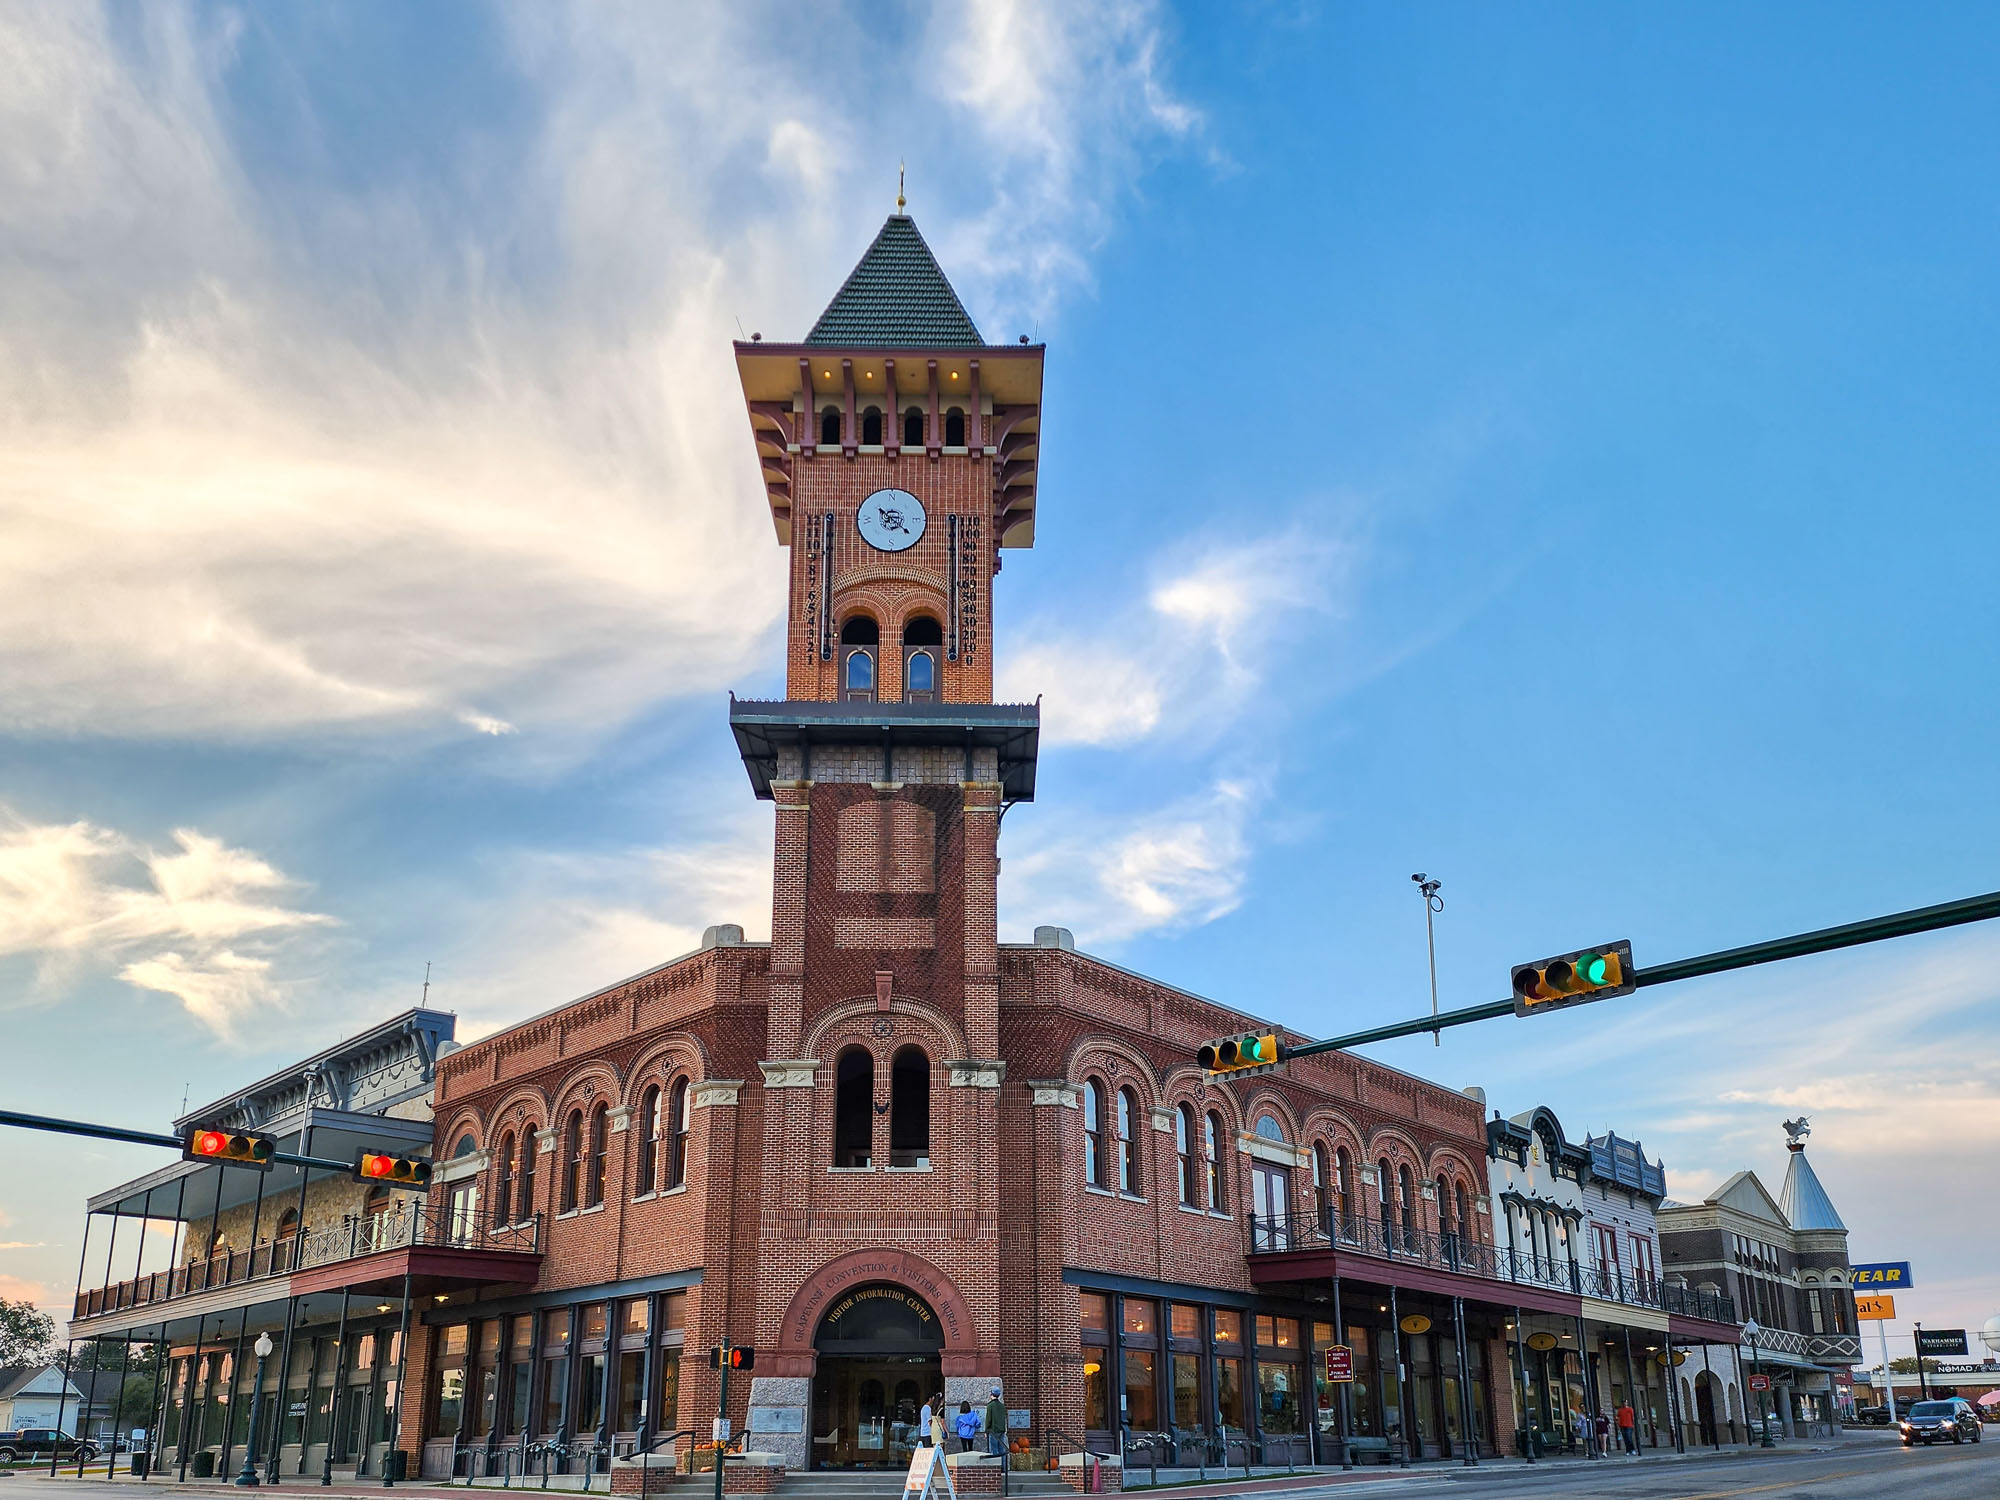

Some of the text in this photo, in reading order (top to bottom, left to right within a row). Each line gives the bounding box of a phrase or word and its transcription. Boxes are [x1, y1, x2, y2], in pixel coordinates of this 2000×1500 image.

[889, 493, 896, 501] N
[807, 514, 820, 526] 12
[960, 516, 980, 526] 110
[807, 528, 819, 537] 11
[960, 529, 980, 539] 100
[807, 541, 820, 550] 10
[963, 541, 976, 551] 90
[963, 554, 976, 564] 80
[809, 564, 816, 575] 8
[963, 566, 976, 576] 70
[808, 591, 816, 601] 6
[962, 592, 976, 602] 50
[807, 603, 816, 613] 5
[962, 604, 976, 614] 40
[807, 617, 815, 626] 4
[962, 617, 977, 627] 30
[807, 629, 814, 639] 3
[962, 630, 976, 640] 20
[807, 642, 814, 652] 2
[963, 643, 976, 653] 10
[966, 655, 973, 665] 0
[1851, 1269, 1901, 1283] YEAR
[794, 1263, 960, 1342] GRAPEVINE CONVENTION & VISITORS BUREAU
[828, 1289, 931, 1323] VISITOR INFORMATION CENTER
[1938, 1365, 1973, 1373] NOMAD
